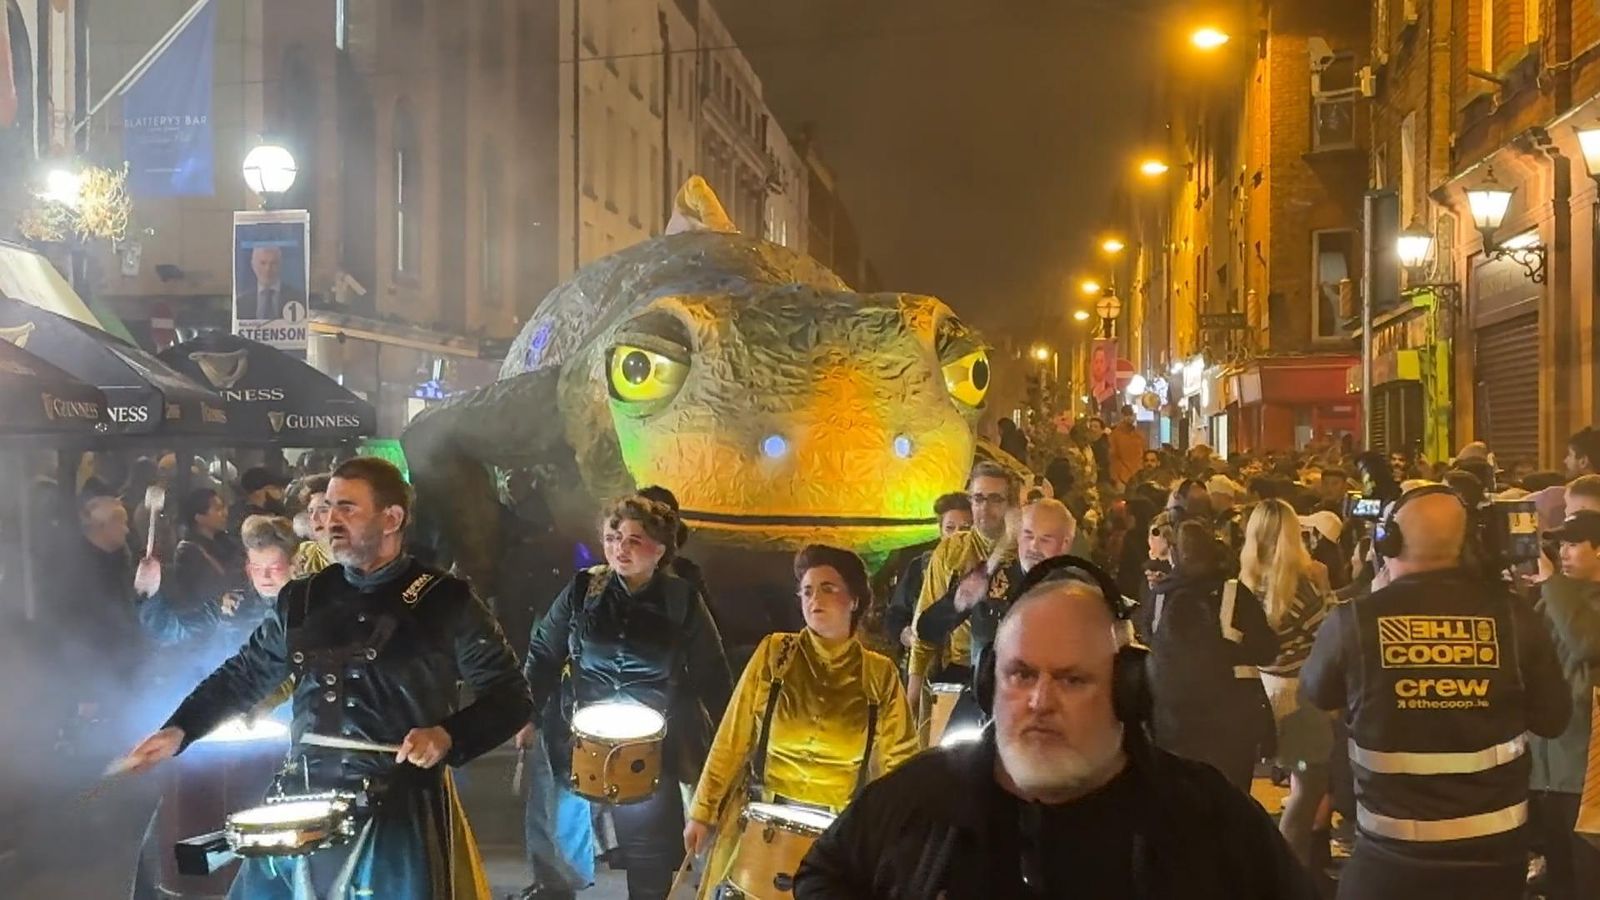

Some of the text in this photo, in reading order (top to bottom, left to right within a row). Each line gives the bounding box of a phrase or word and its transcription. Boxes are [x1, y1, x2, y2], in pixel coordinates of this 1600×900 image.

[184, 115, 207, 126] BAR
[288, 302, 298, 322] 1
[220, 388, 285, 401] NESS
[286, 414, 360, 429] GUINNESS
[1385, 644, 1475, 664] COOP
[1394, 679, 1490, 697] crew
